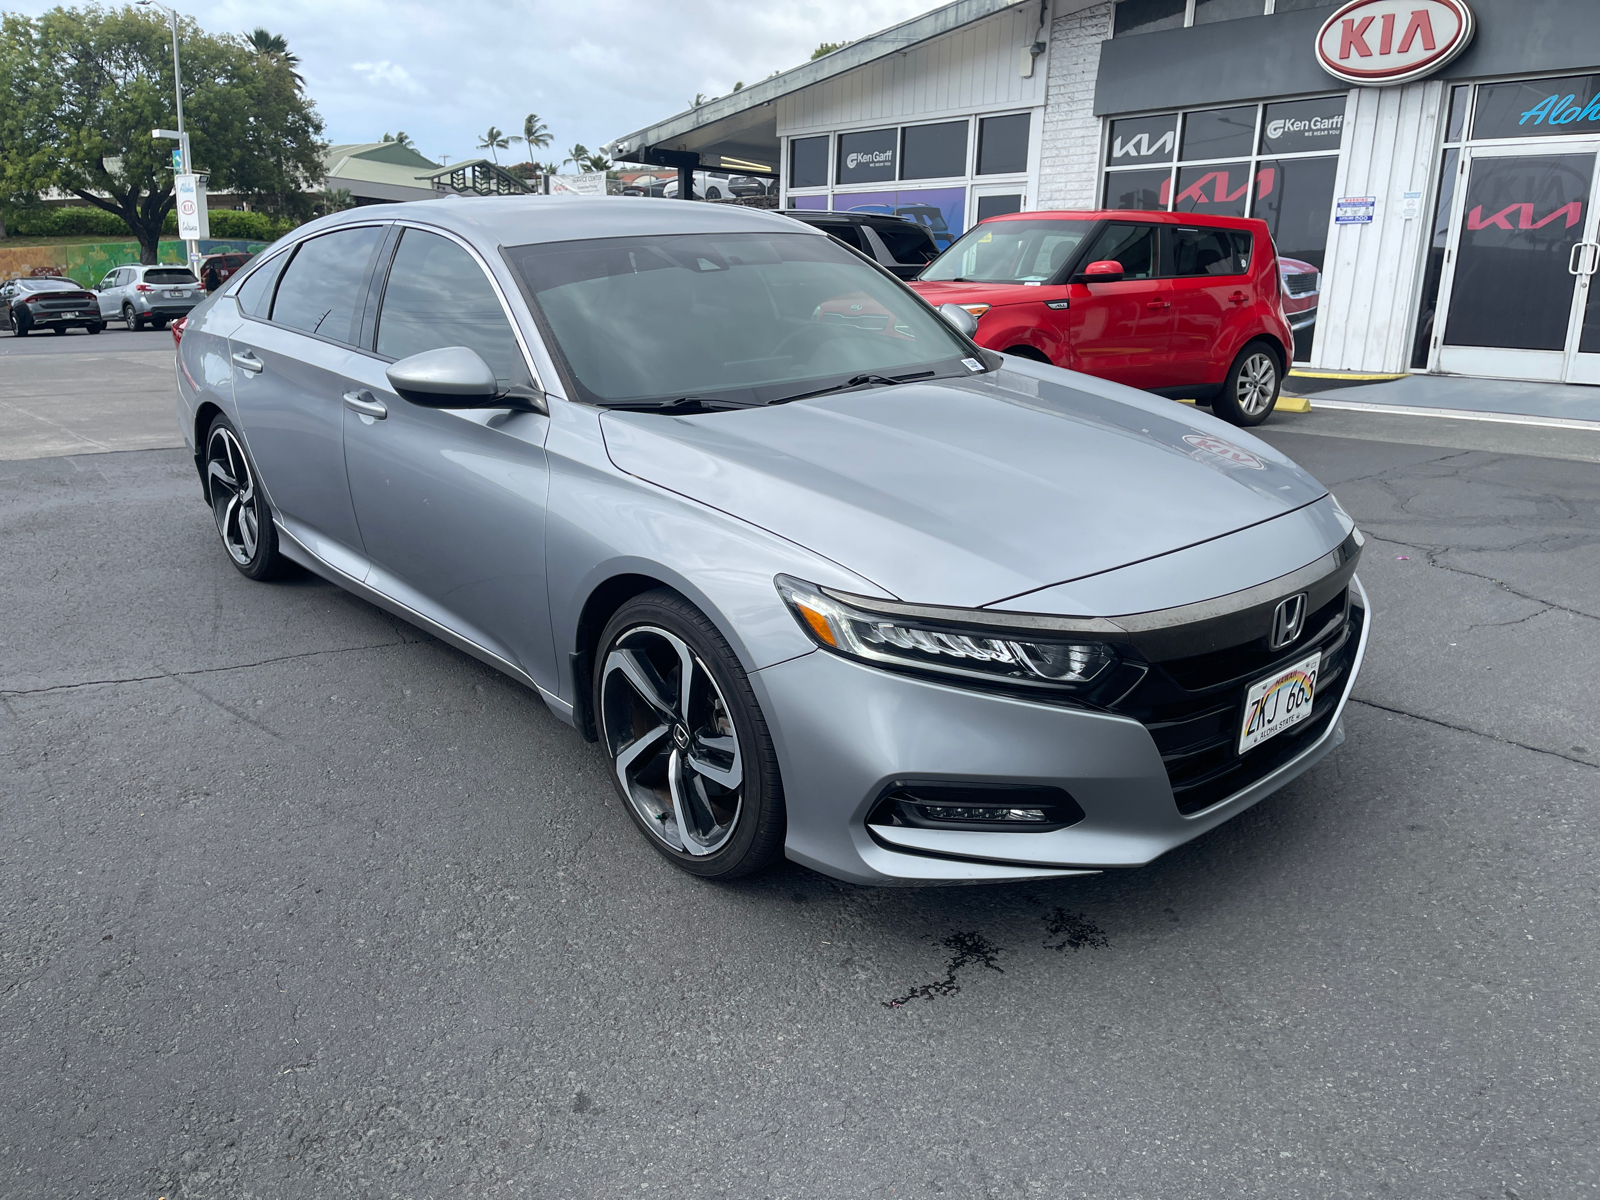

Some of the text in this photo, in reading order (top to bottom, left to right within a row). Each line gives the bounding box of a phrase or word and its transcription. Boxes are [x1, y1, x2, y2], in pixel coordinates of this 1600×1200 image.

[1339, 9, 1436, 60] KIA
[1284, 115, 1343, 132] Ken Garff
[857, 150, 892, 163] Ken Garff
[1113, 131, 1175, 158] KIA
[1159, 168, 1275, 205] KIA
[1467, 201, 1582, 230] KIA
[1246, 670, 1316, 737] ZKJ 663
[1260, 714, 1295, 740] ALOHA STATE
